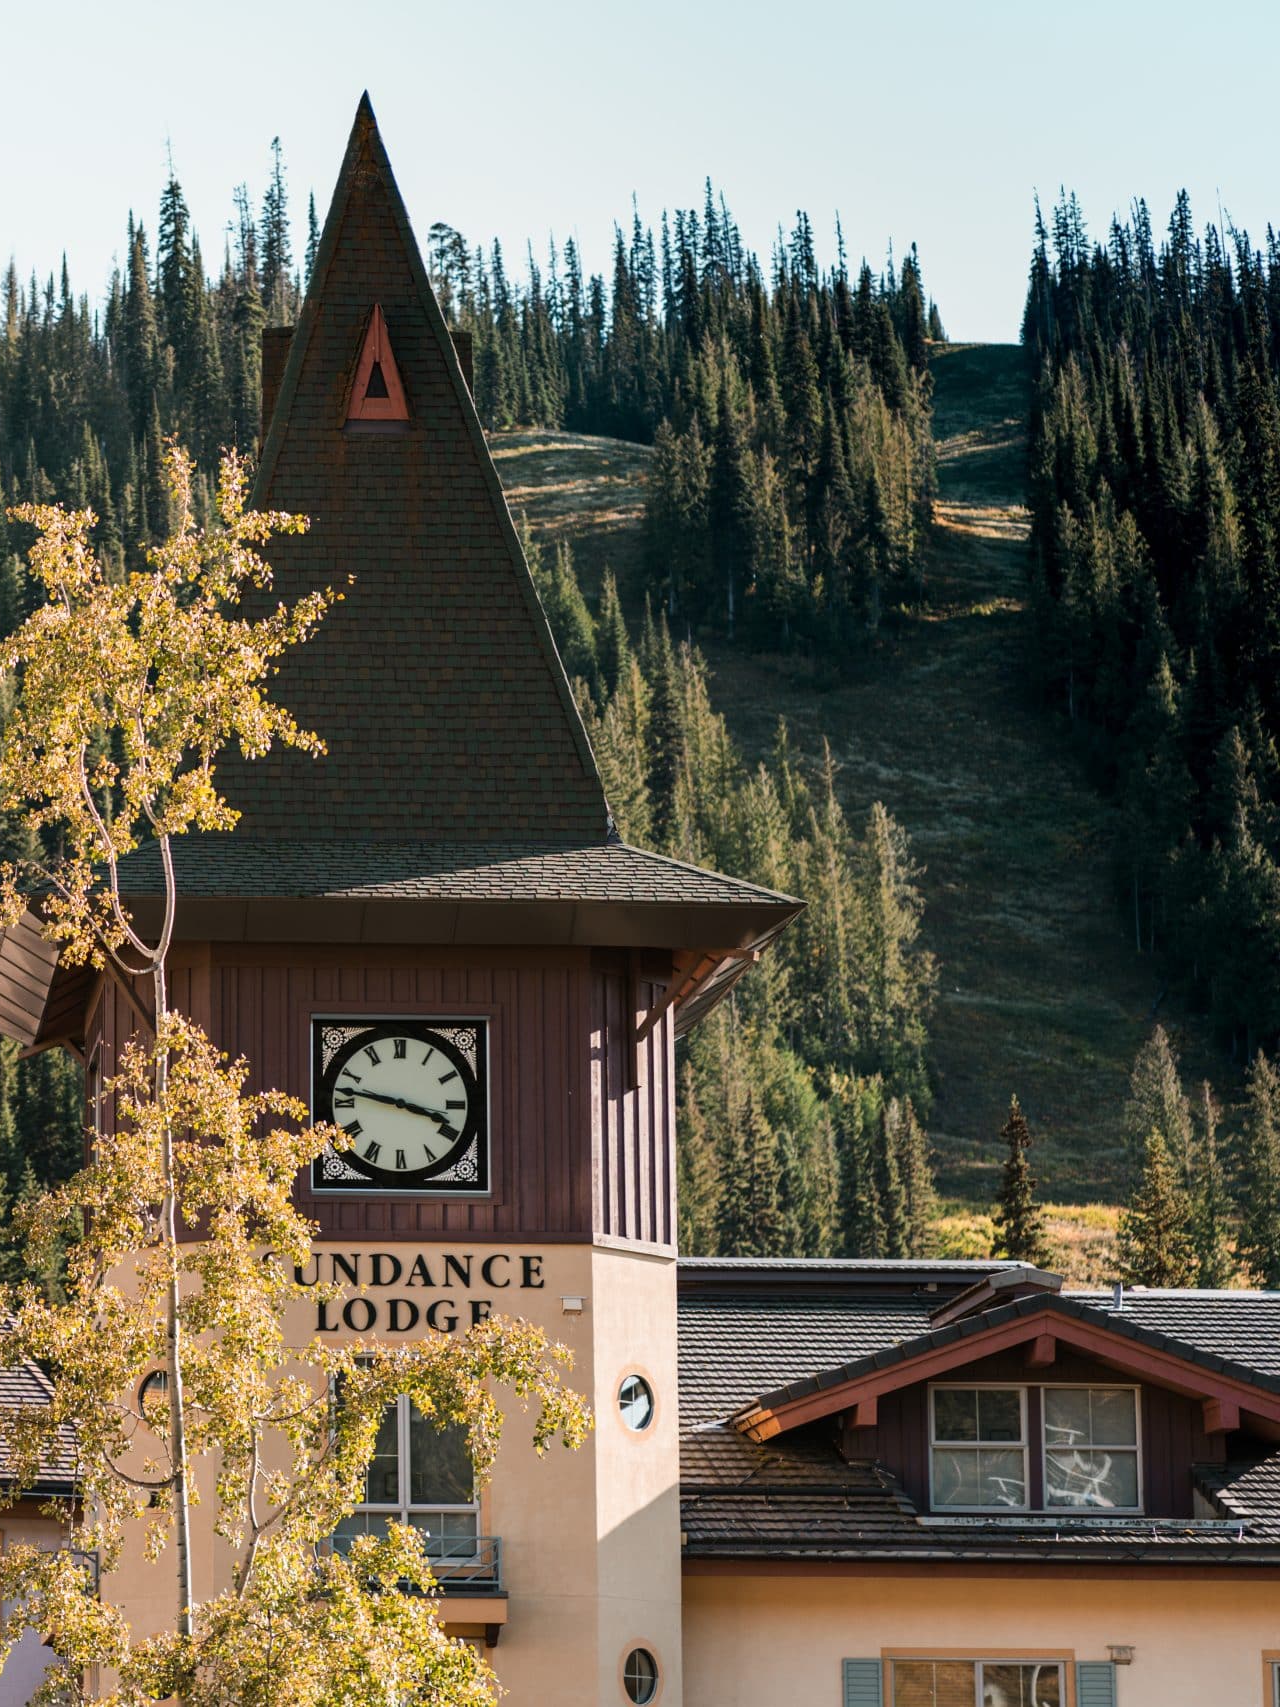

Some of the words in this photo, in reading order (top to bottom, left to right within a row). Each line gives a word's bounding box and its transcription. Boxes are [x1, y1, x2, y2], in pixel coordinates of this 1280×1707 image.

[363, 1045, 382, 1067] XI
[422, 1047, 434, 1066] I
[341, 1067, 362, 1084] X
[334, 1097, 355, 1109] IX
[445, 1100, 466, 1110] III
[396, 1149, 407, 1169] VI
[423, 1143, 437, 1163] V
[262, 1251, 545, 1289] UNDANCE
